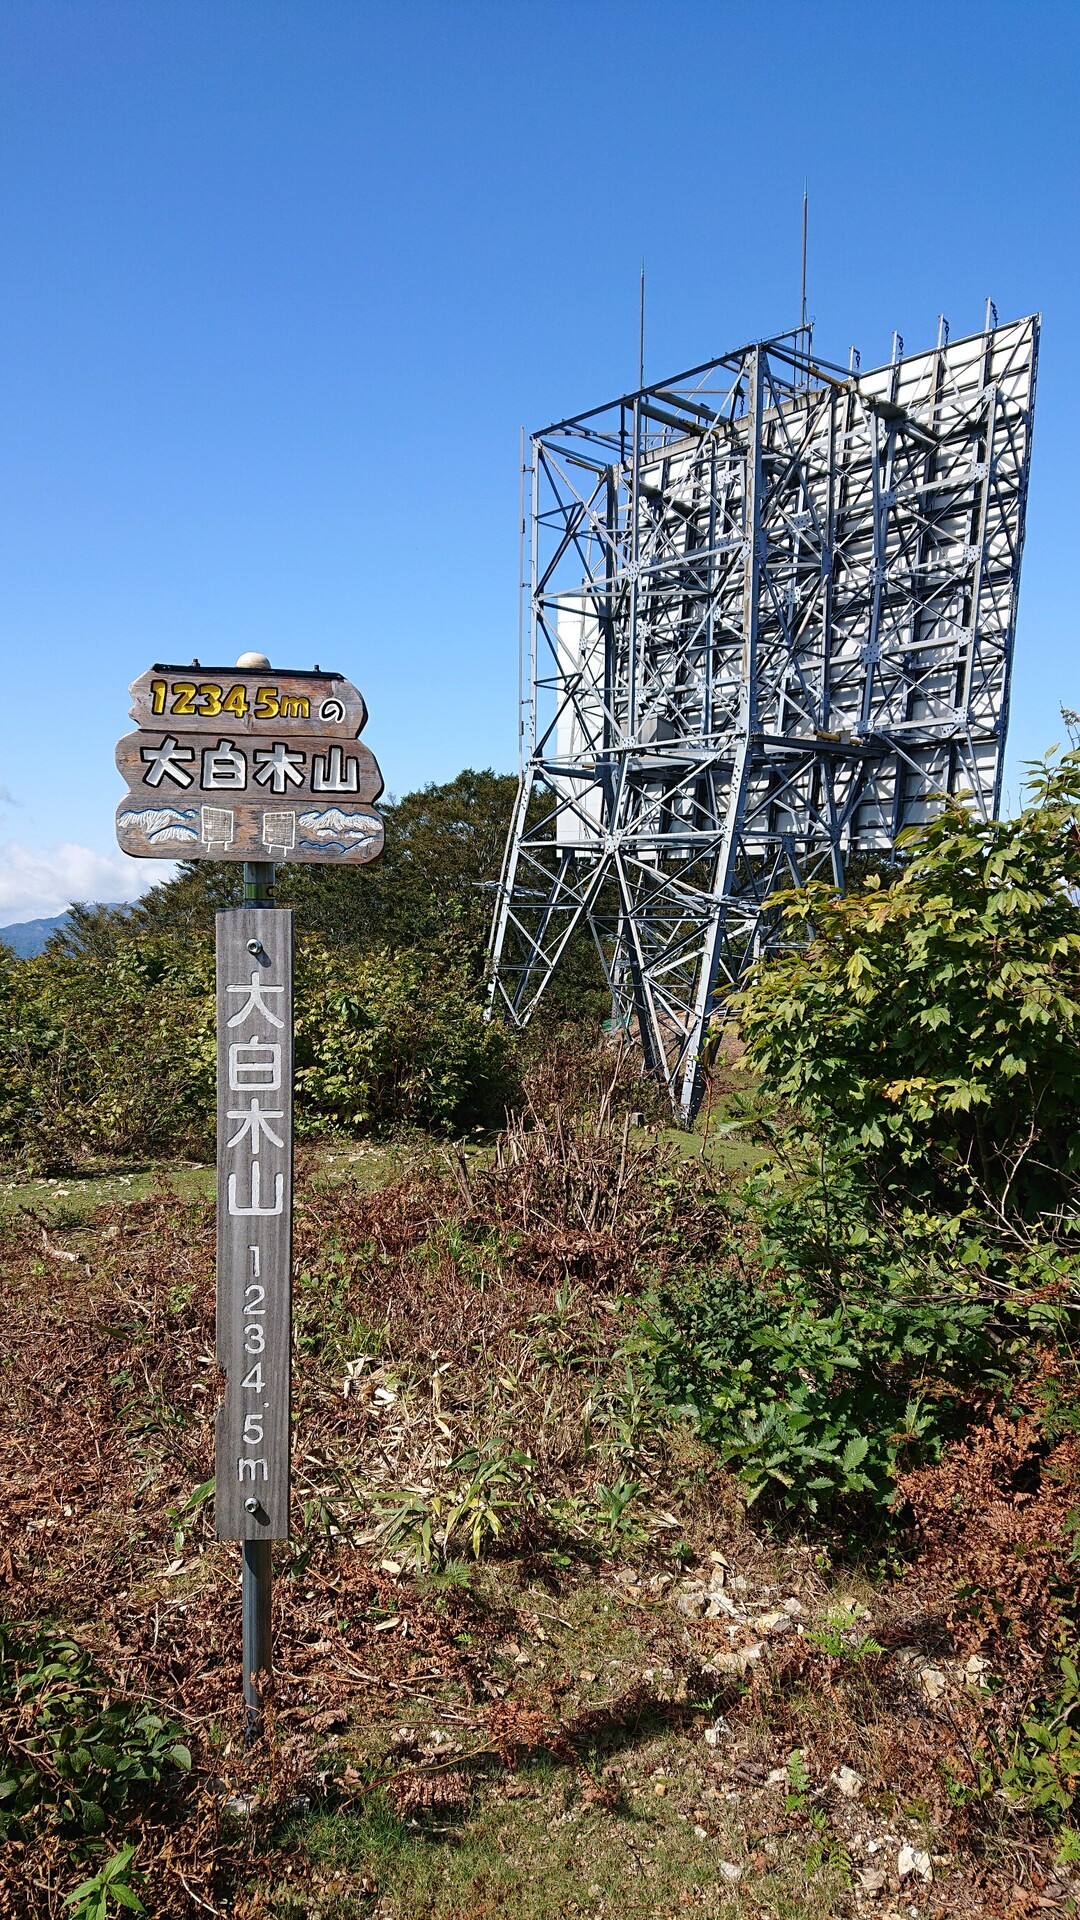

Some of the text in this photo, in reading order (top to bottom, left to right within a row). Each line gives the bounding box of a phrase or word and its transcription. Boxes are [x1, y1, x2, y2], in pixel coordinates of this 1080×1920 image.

[140, 734, 360, 794] 大白木山
[226, 970, 284, 1216] 大白木山
